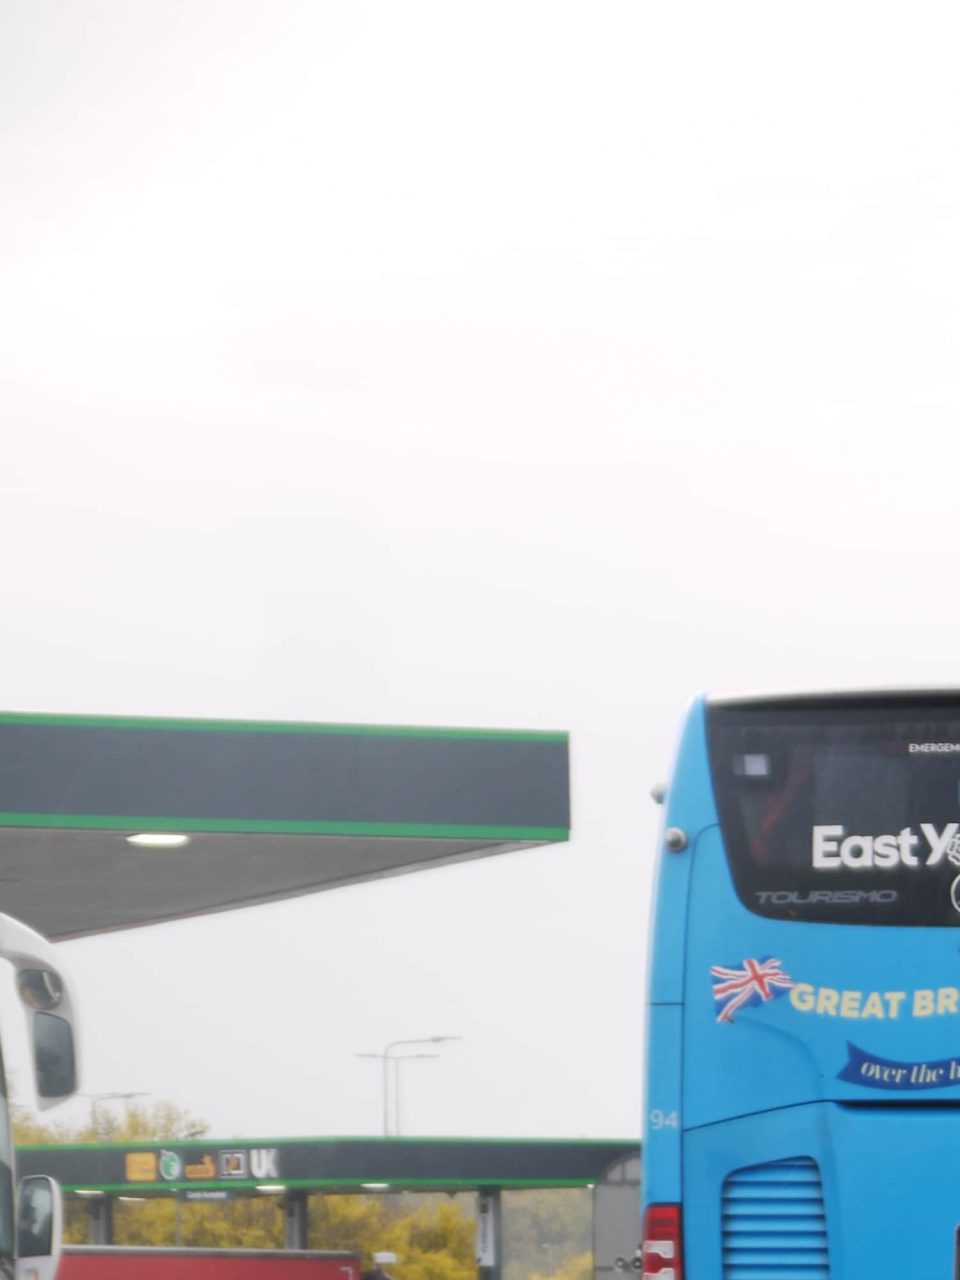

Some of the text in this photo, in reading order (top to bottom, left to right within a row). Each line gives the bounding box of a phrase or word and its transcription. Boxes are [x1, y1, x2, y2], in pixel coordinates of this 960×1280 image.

[754, 889, 898, 904] TOURISMO
[789, 982, 906, 1019] GREAT
[860, 1061, 907, 1084] over
[910, 1063, 945, 1084] the
[649, 1108, 678, 1130] 94
